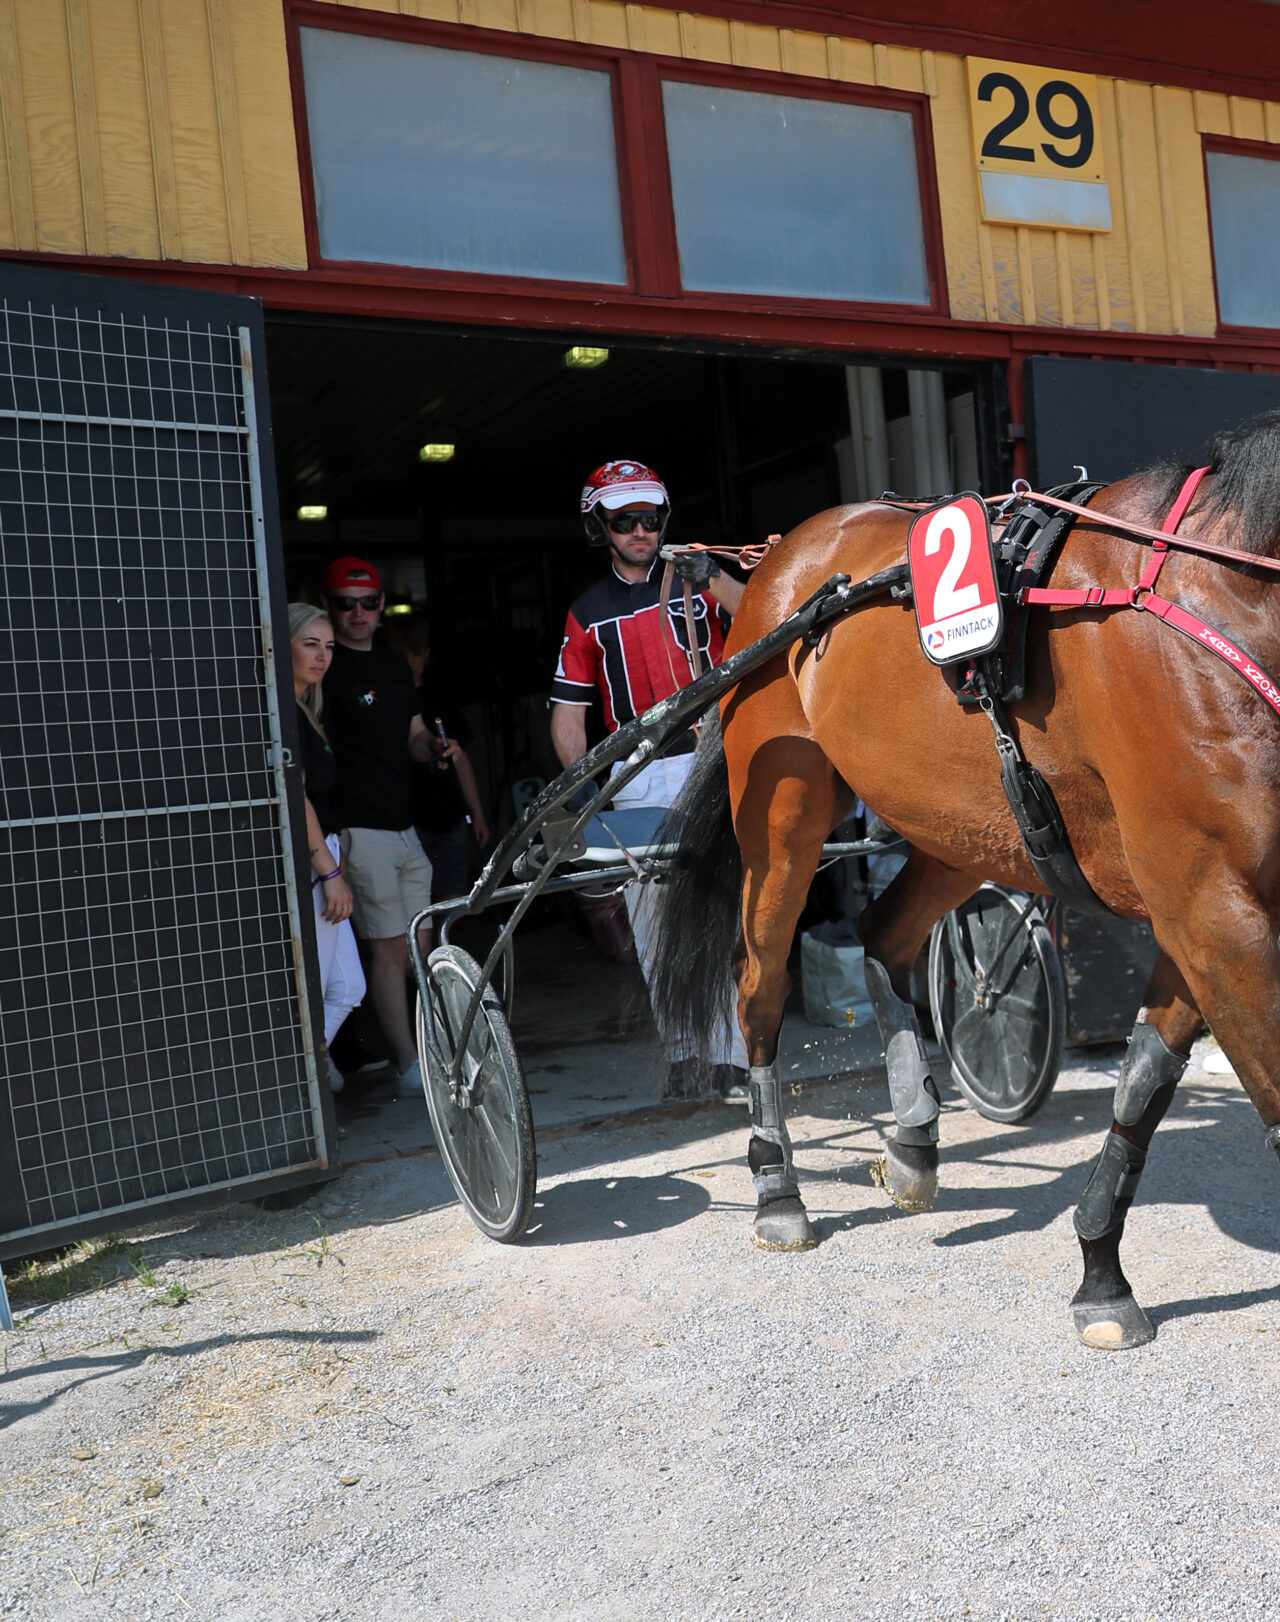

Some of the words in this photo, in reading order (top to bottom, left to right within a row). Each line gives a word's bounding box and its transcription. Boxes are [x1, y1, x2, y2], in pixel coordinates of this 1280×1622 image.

[977, 72, 1094, 169] 29
[924, 505, 981, 621] 2
[947, 616, 994, 642] FINNTACK
[1199, 628, 1242, 662] HARRY
